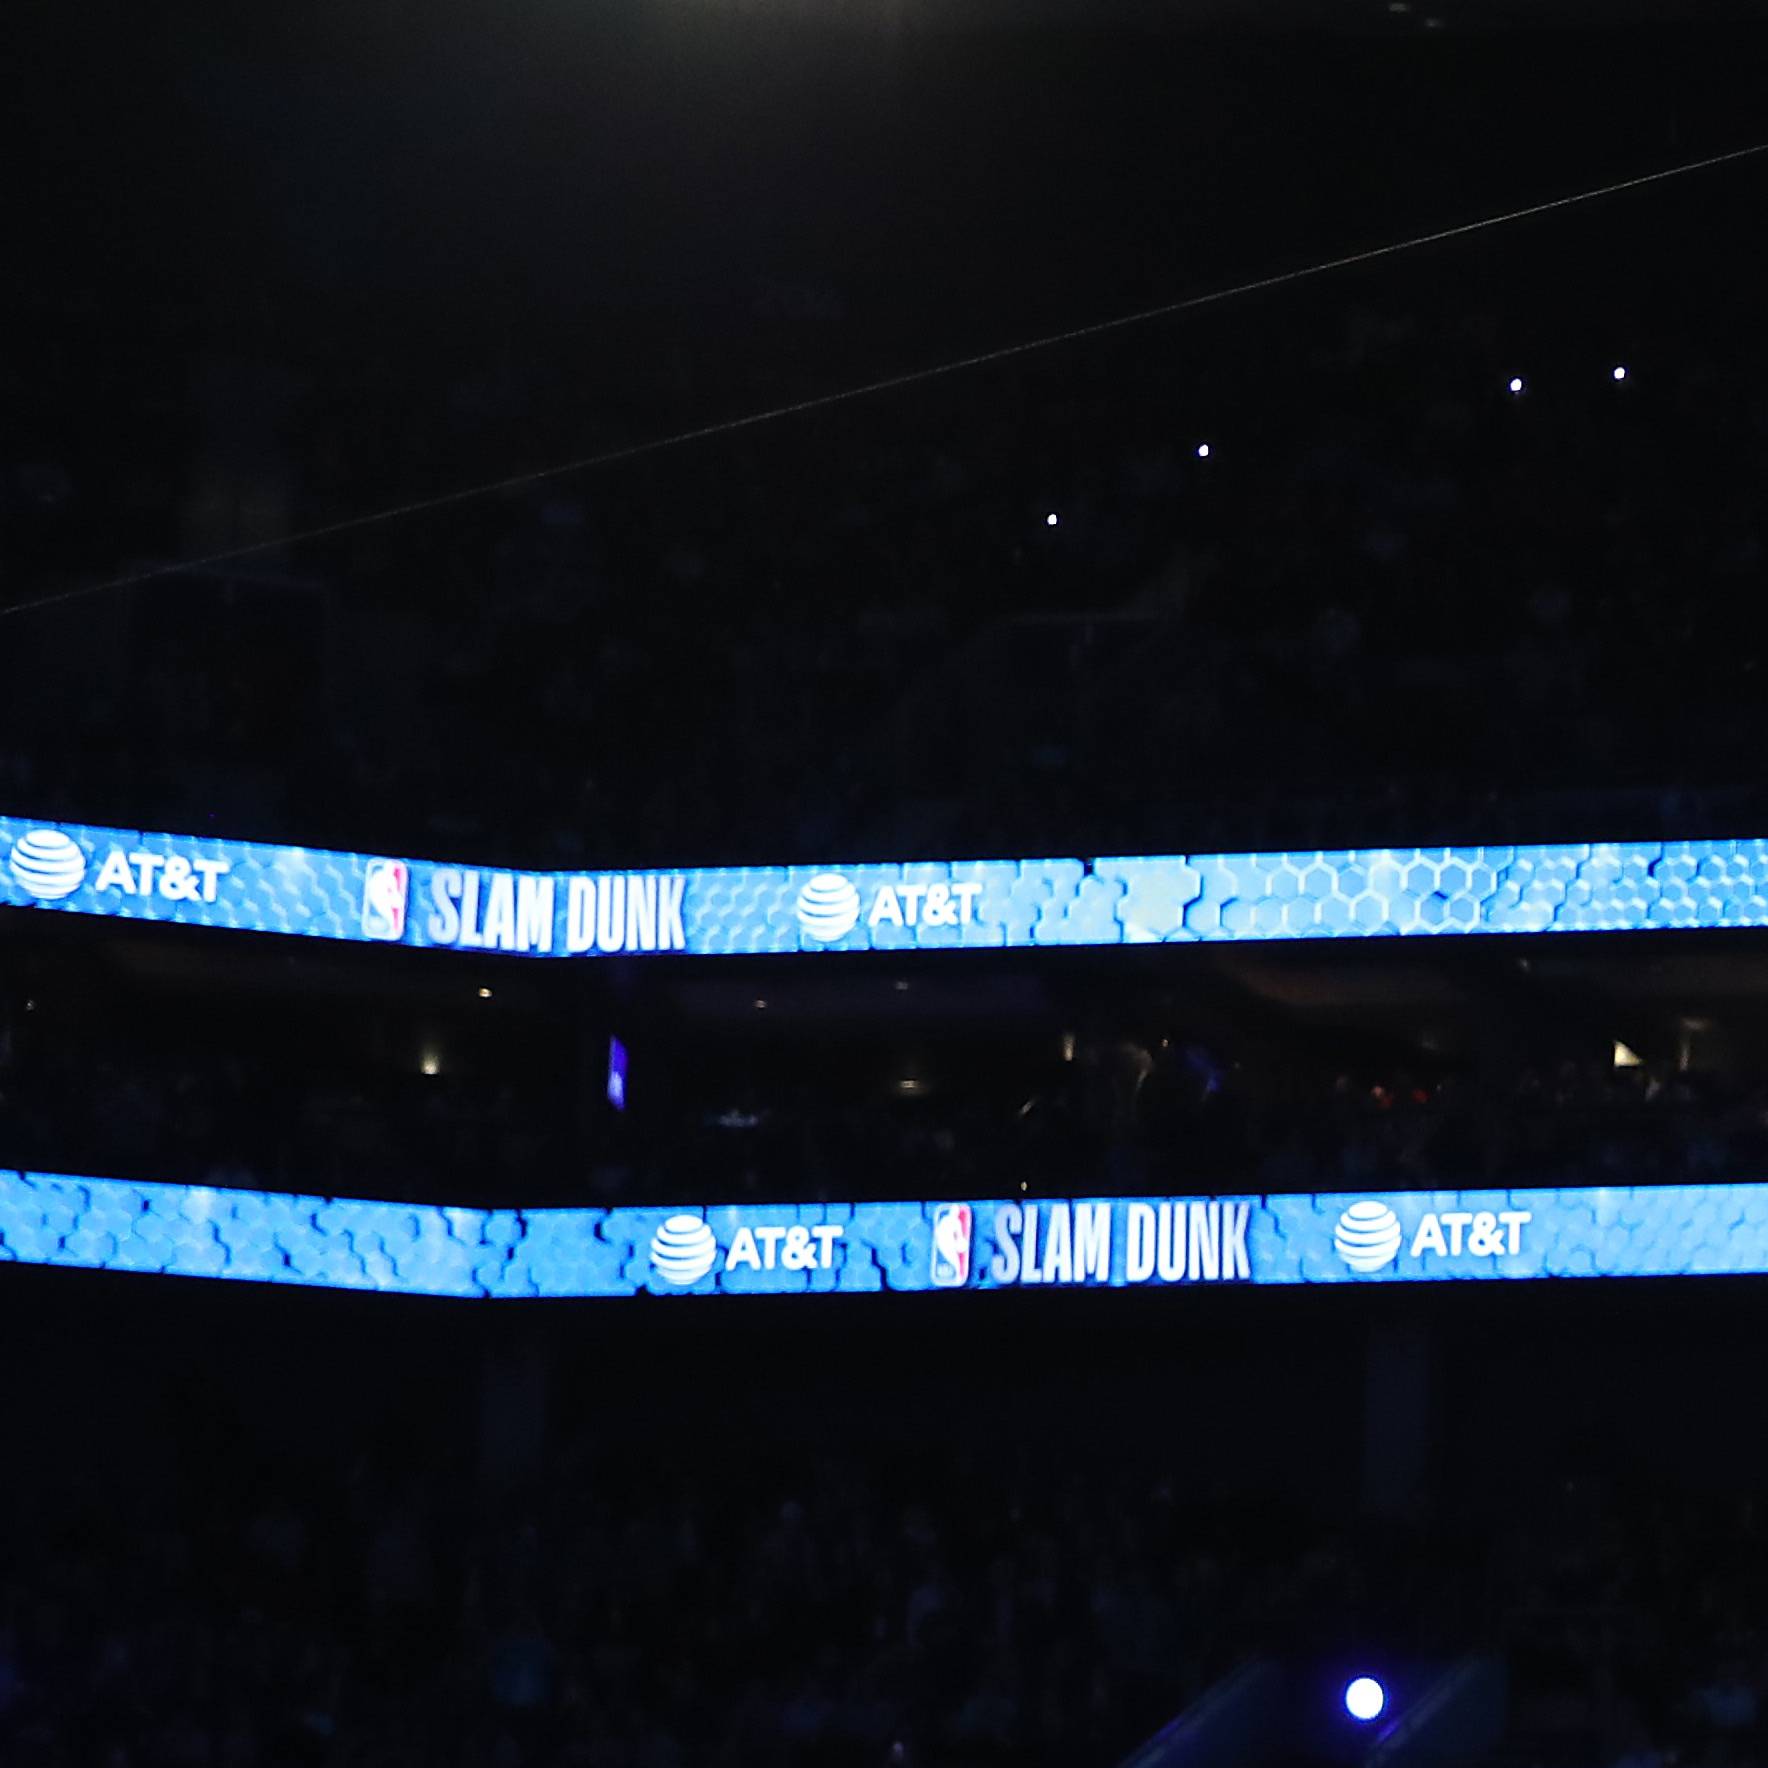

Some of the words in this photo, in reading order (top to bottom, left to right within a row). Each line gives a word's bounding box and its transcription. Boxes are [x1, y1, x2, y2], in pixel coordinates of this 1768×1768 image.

[95, 851, 229, 902] AT&T
[428, 869, 554, 952] SLAM
[567, 874, 686, 953] DUNK
[869, 883, 982, 928] AT&T
[726, 1225, 843, 1270] AT&T
[992, 1204, 1110, 1282] SLAM
[1126, 1203, 1250, 1281] DUNK
[1411, 1211, 1531, 1257] AT&T
